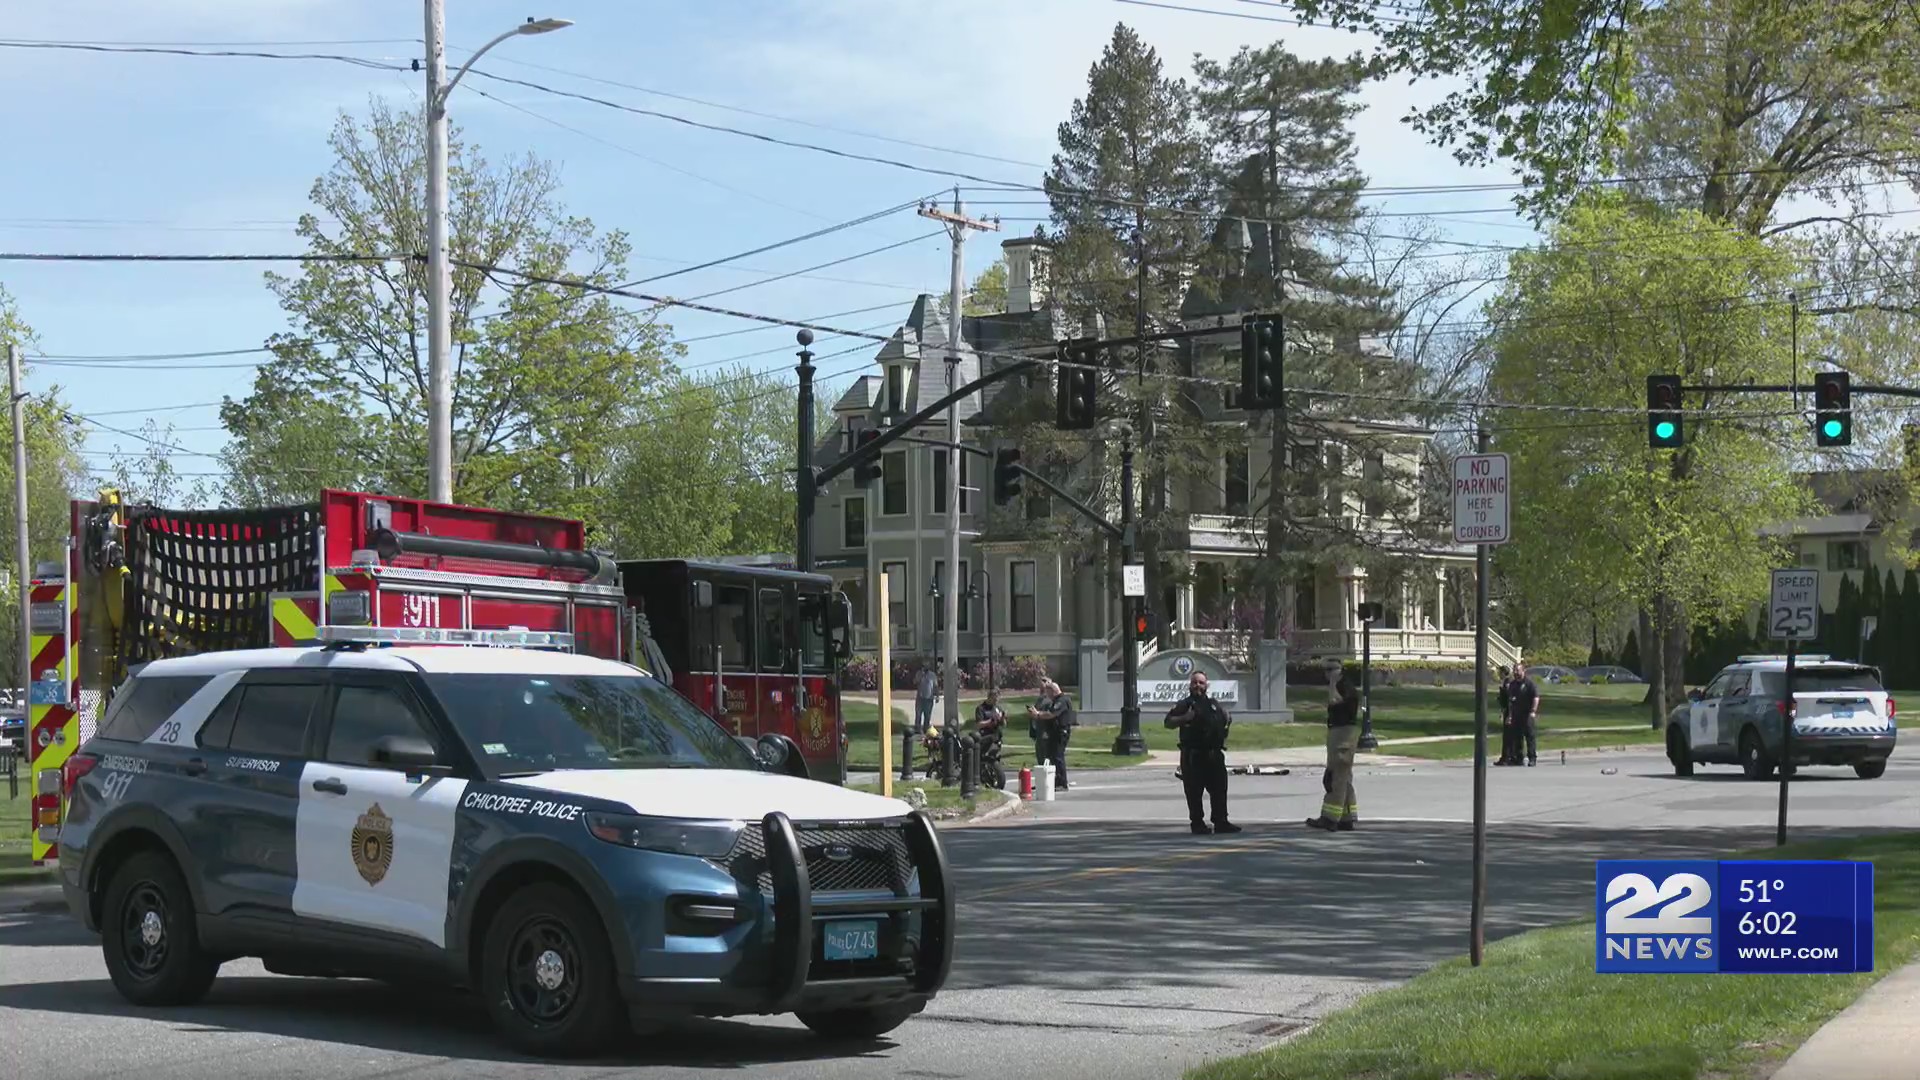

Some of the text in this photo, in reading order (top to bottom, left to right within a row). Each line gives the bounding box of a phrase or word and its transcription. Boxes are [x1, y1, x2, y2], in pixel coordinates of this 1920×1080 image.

[1471, 460, 1490, 476] NO
[1456, 477, 1504, 495] PARKING
[1467, 498, 1493, 510] HERE
[1474, 511, 1486, 523] TO
[1460, 525, 1501, 538] CORNER
[1778, 576, 1814, 588] SPEED
[1780, 592, 1808, 602] LIMIT
[409, 594, 440, 628] 911
[1774, 607, 1813, 631] 25
[159, 721, 181, 743] 28
[102, 754, 149, 773] EMERGENCY
[225, 756, 280, 772] SUPERVISOR
[101, 771, 133, 800] 911
[464, 792, 582, 820] CHICOPEE POLICE
[845, 930, 876, 950] C743
